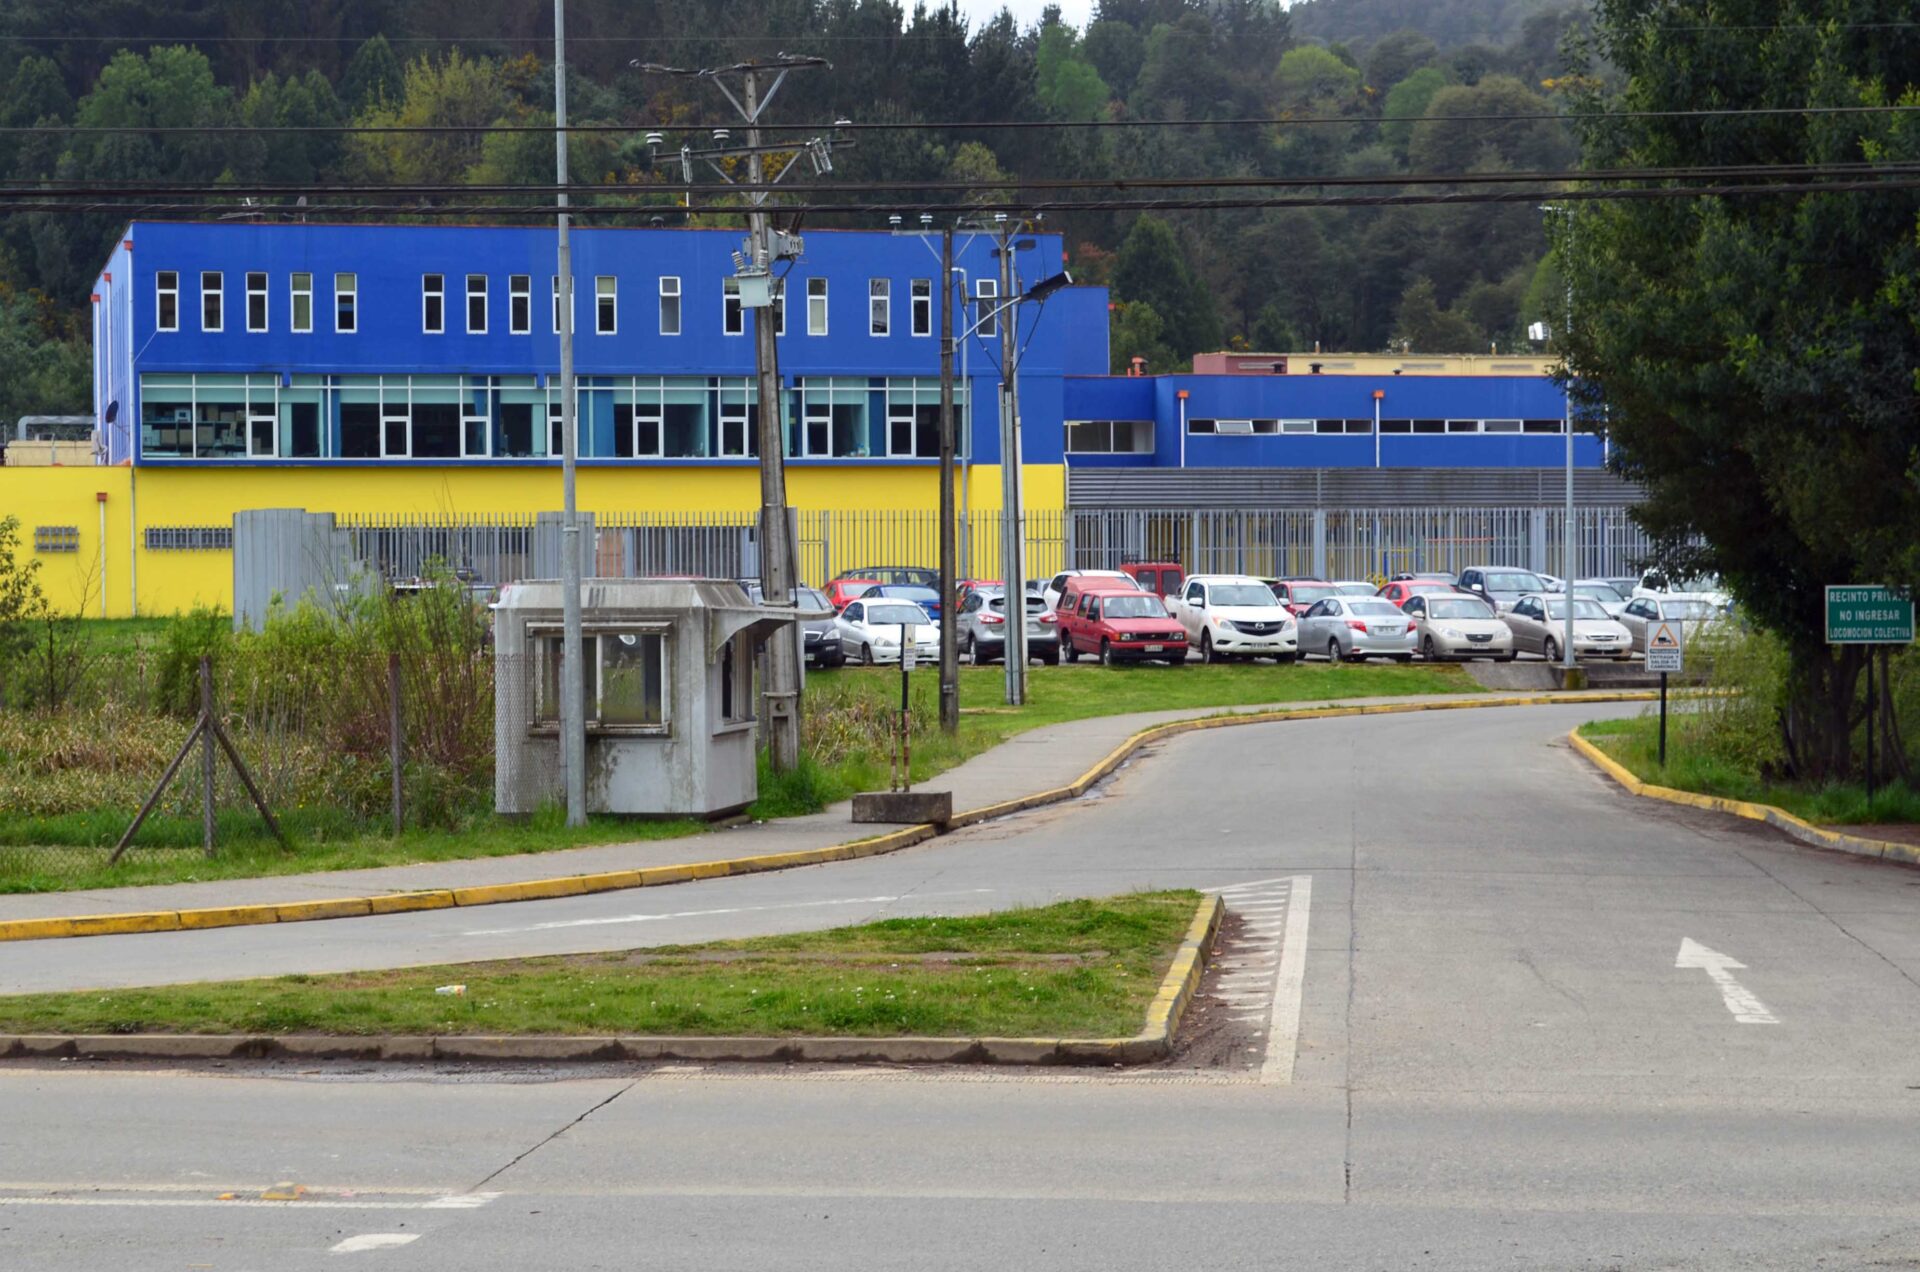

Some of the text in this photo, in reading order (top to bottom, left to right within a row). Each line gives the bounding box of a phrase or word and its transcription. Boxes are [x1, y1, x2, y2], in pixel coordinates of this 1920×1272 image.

[1830, 591, 1868, 602] RECINTO
[1840, 610, 1900, 621] NO INGRESAR
[1830, 627, 1910, 638] LOCOMOCION COLECTIVA
